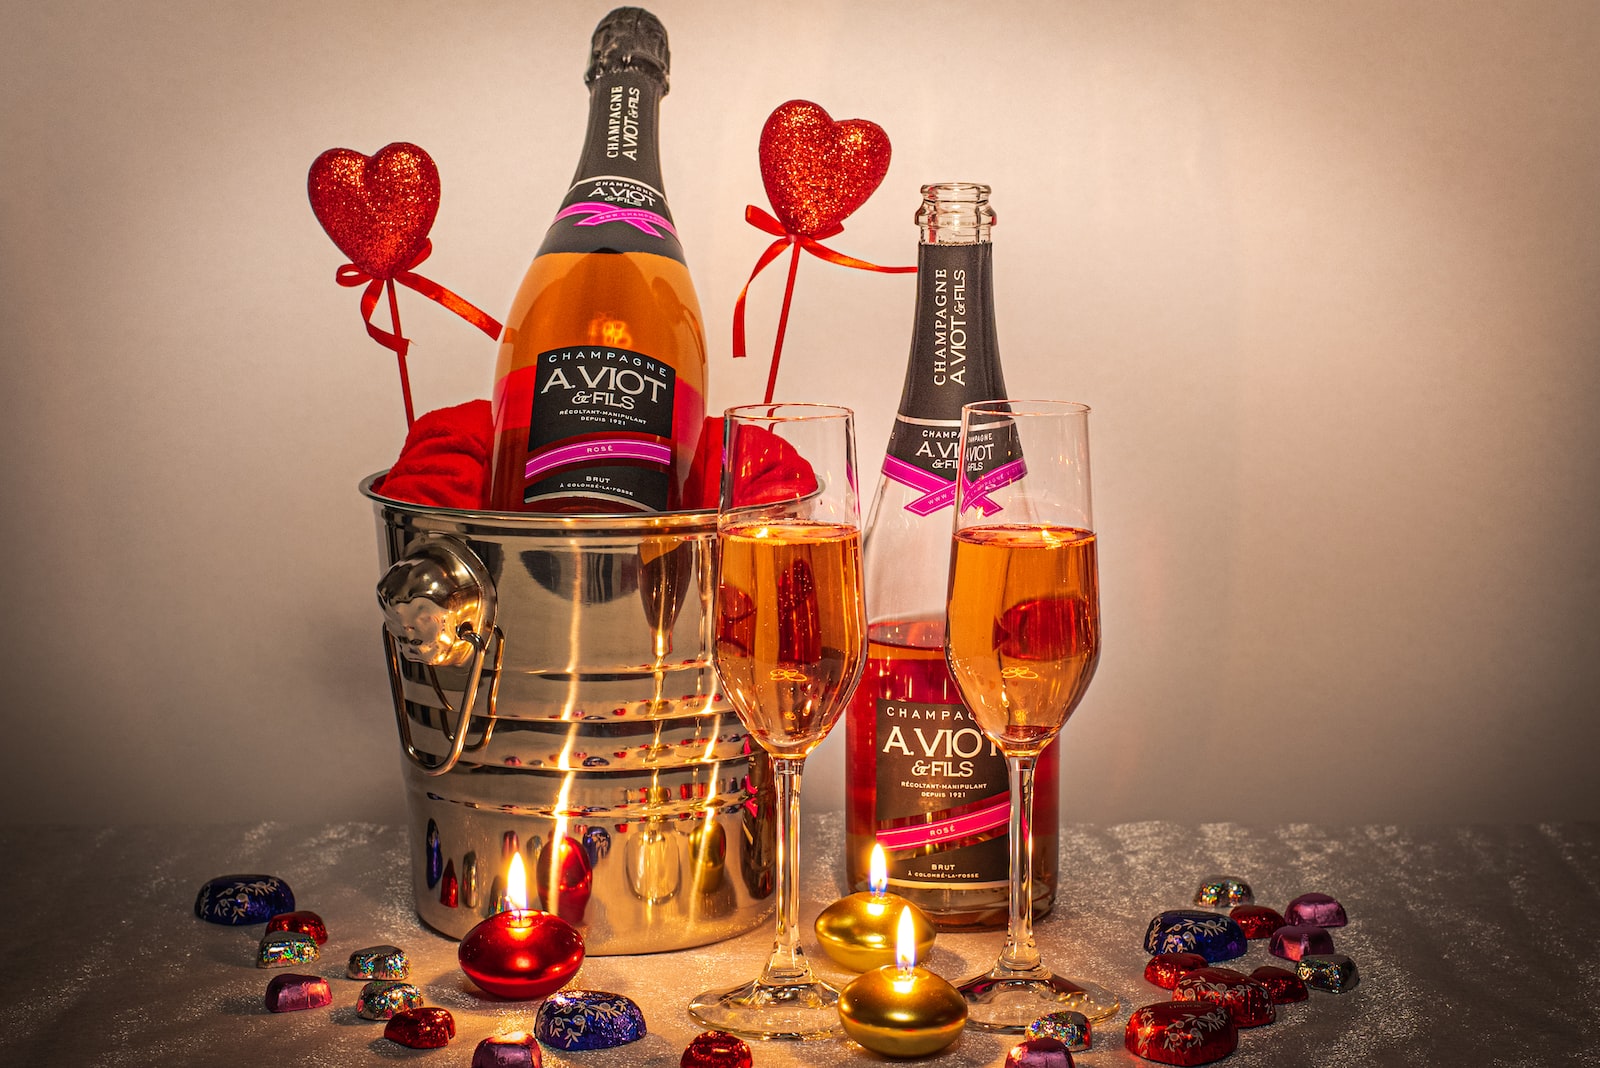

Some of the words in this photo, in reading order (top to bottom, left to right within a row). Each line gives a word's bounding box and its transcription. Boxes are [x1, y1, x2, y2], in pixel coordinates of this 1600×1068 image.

[606, 85, 623, 158] CHAMPAGNE
[595, 181, 654, 198] CHAMPAGNE
[934, 269, 947, 386] CHAMPAGNE
[548, 351, 667, 378] CHAMPAGNE
[609, 418, 626, 426] 1921
[586, 444, 613, 453] ROSÉ
[915, 440, 960, 459] A.VI
[585, 475, 610, 484] BRUT
[929, 824, 955, 836] ROSÉ
[931, 863, 956, 871] BRUT
